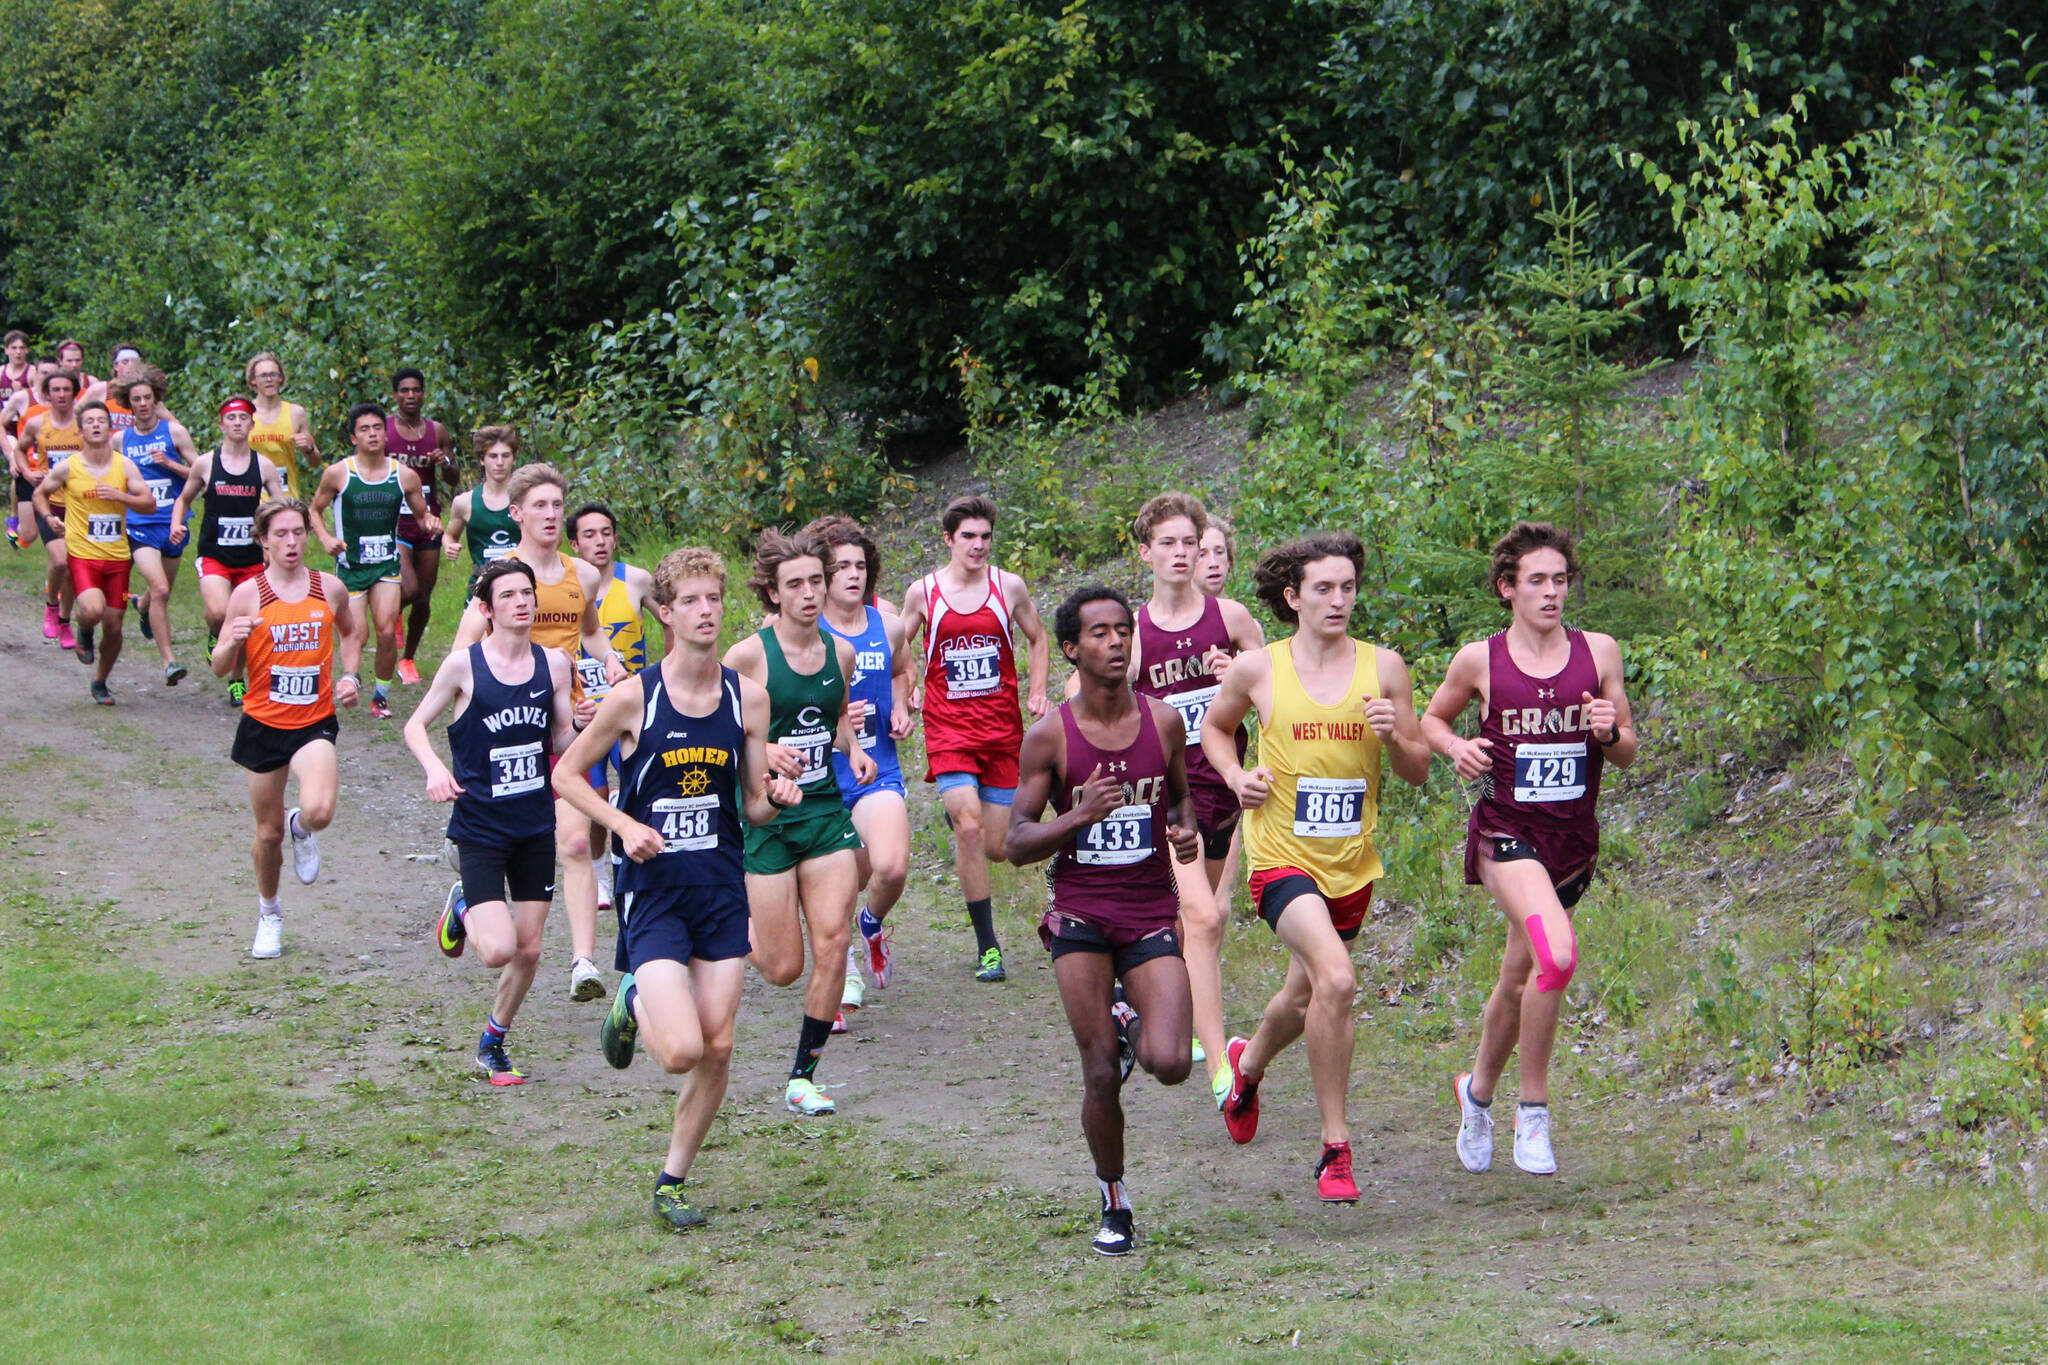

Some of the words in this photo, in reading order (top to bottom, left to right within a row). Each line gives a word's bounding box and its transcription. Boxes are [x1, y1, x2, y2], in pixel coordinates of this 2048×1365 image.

[127, 441, 167, 458] PALMER
[252, 434, 265, 443] WEST
[215, 484, 257, 496] WASILLA
[93, 521, 118, 536] 871
[223, 525, 249, 538] 776
[364, 543, 388, 557] 586
[269, 621, 322, 643] WEST
[272, 641, 319, 653] ANCHORAGE
[953, 658, 992, 681] 394
[1148, 648, 1230, 689] GRAC
[277, 675, 314, 695] 800
[482, 706, 548, 733] WOLVES
[1178, 702, 1210, 732] 42
[1292, 723, 1323, 741] WEST
[1327, 723, 1365, 741] VALLEY
[661, 747, 729, 768] HOMER
[794, 745, 824, 771] 19
[499, 755, 537, 783] 348
[1525, 758, 1577, 787] 429
[1306, 793, 1355, 823] 866
[661, 809, 710, 839] 458
[1087, 820, 1141, 850] 433
